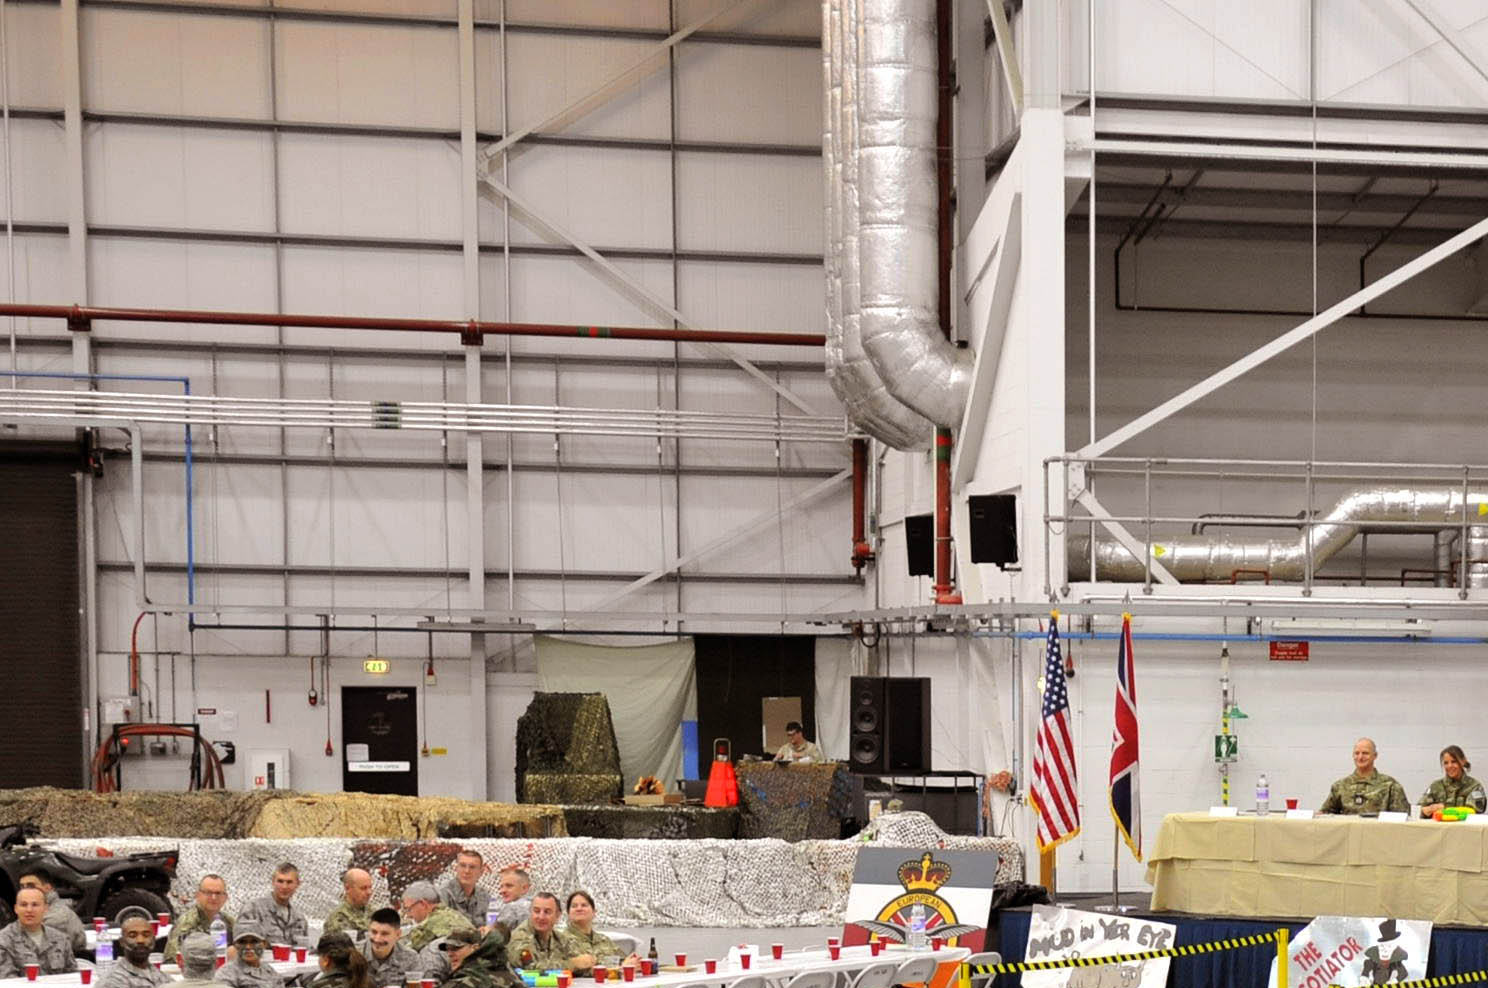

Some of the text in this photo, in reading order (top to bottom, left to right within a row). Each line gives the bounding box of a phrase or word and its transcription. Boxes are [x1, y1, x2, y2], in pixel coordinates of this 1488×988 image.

[896, 893, 943, 909] EUROPEAN
[1029, 928, 1075, 960] MUD
[1098, 918, 1131, 942] YER
[1136, 924, 1172, 950] EYE
[1293, 941, 1323, 972] THE
